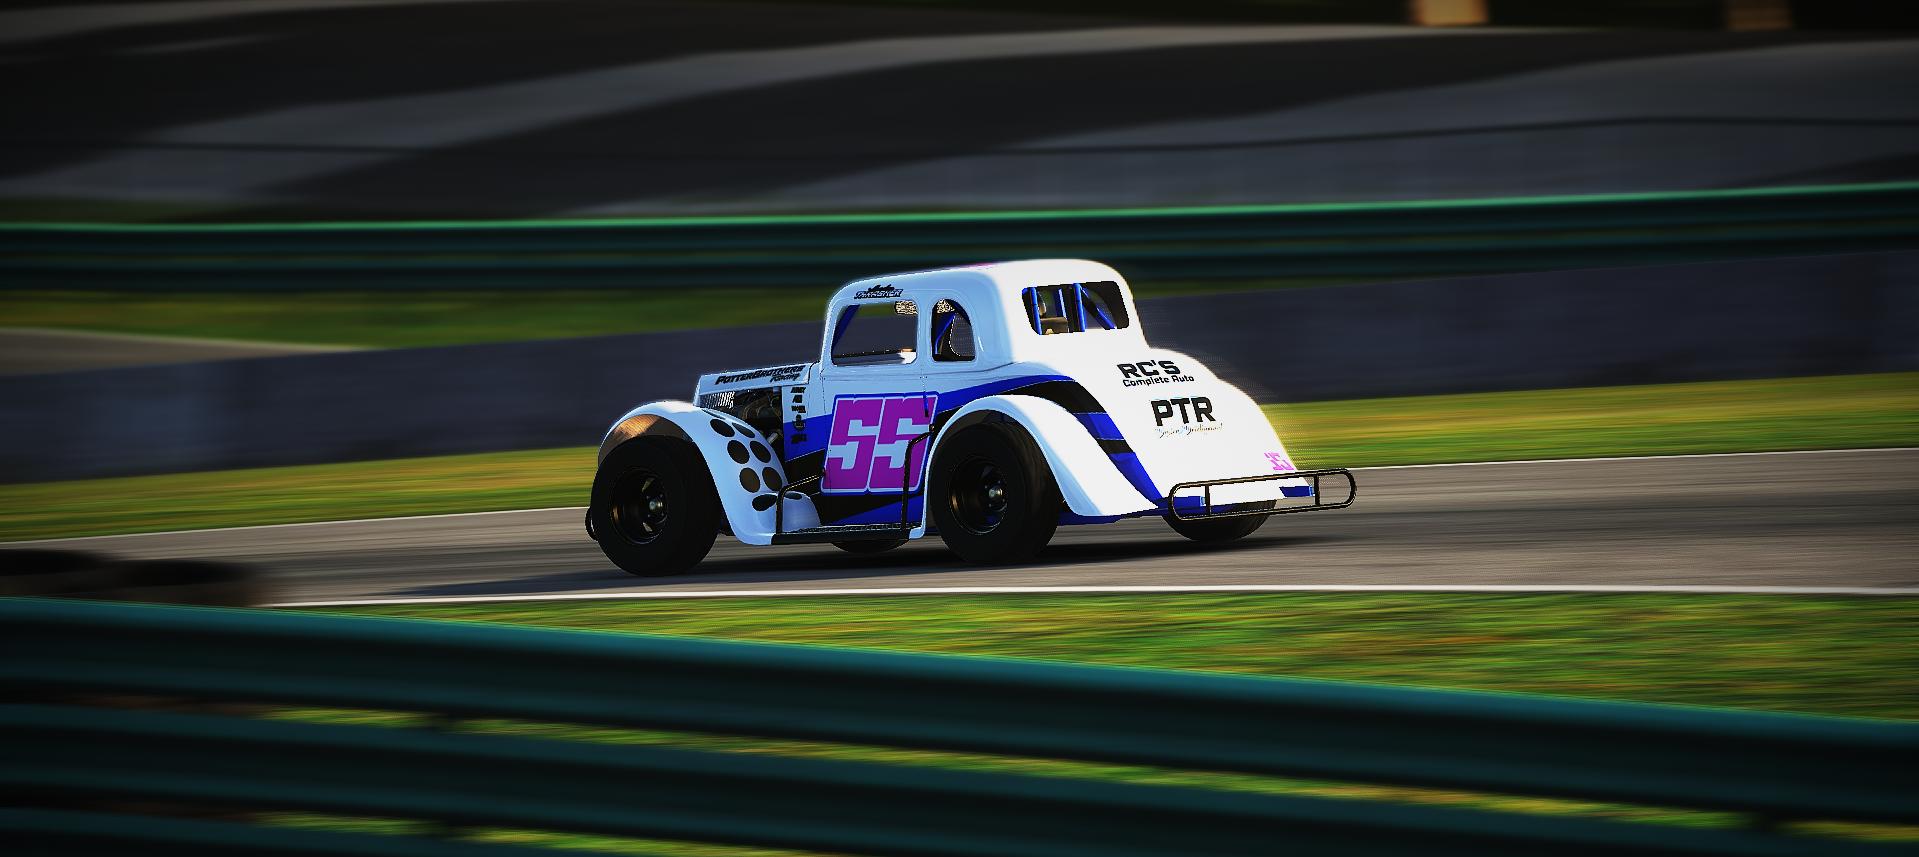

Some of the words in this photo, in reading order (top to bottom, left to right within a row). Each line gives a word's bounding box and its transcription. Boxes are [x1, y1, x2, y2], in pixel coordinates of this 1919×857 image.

[1117, 360, 1181, 378] RC'S
[1123, 377, 1170, 387] Complete
[1172, 375, 1195, 383] Auto
[1151, 397, 1216, 426] PTR
[821, 394, 938, 492] 55
